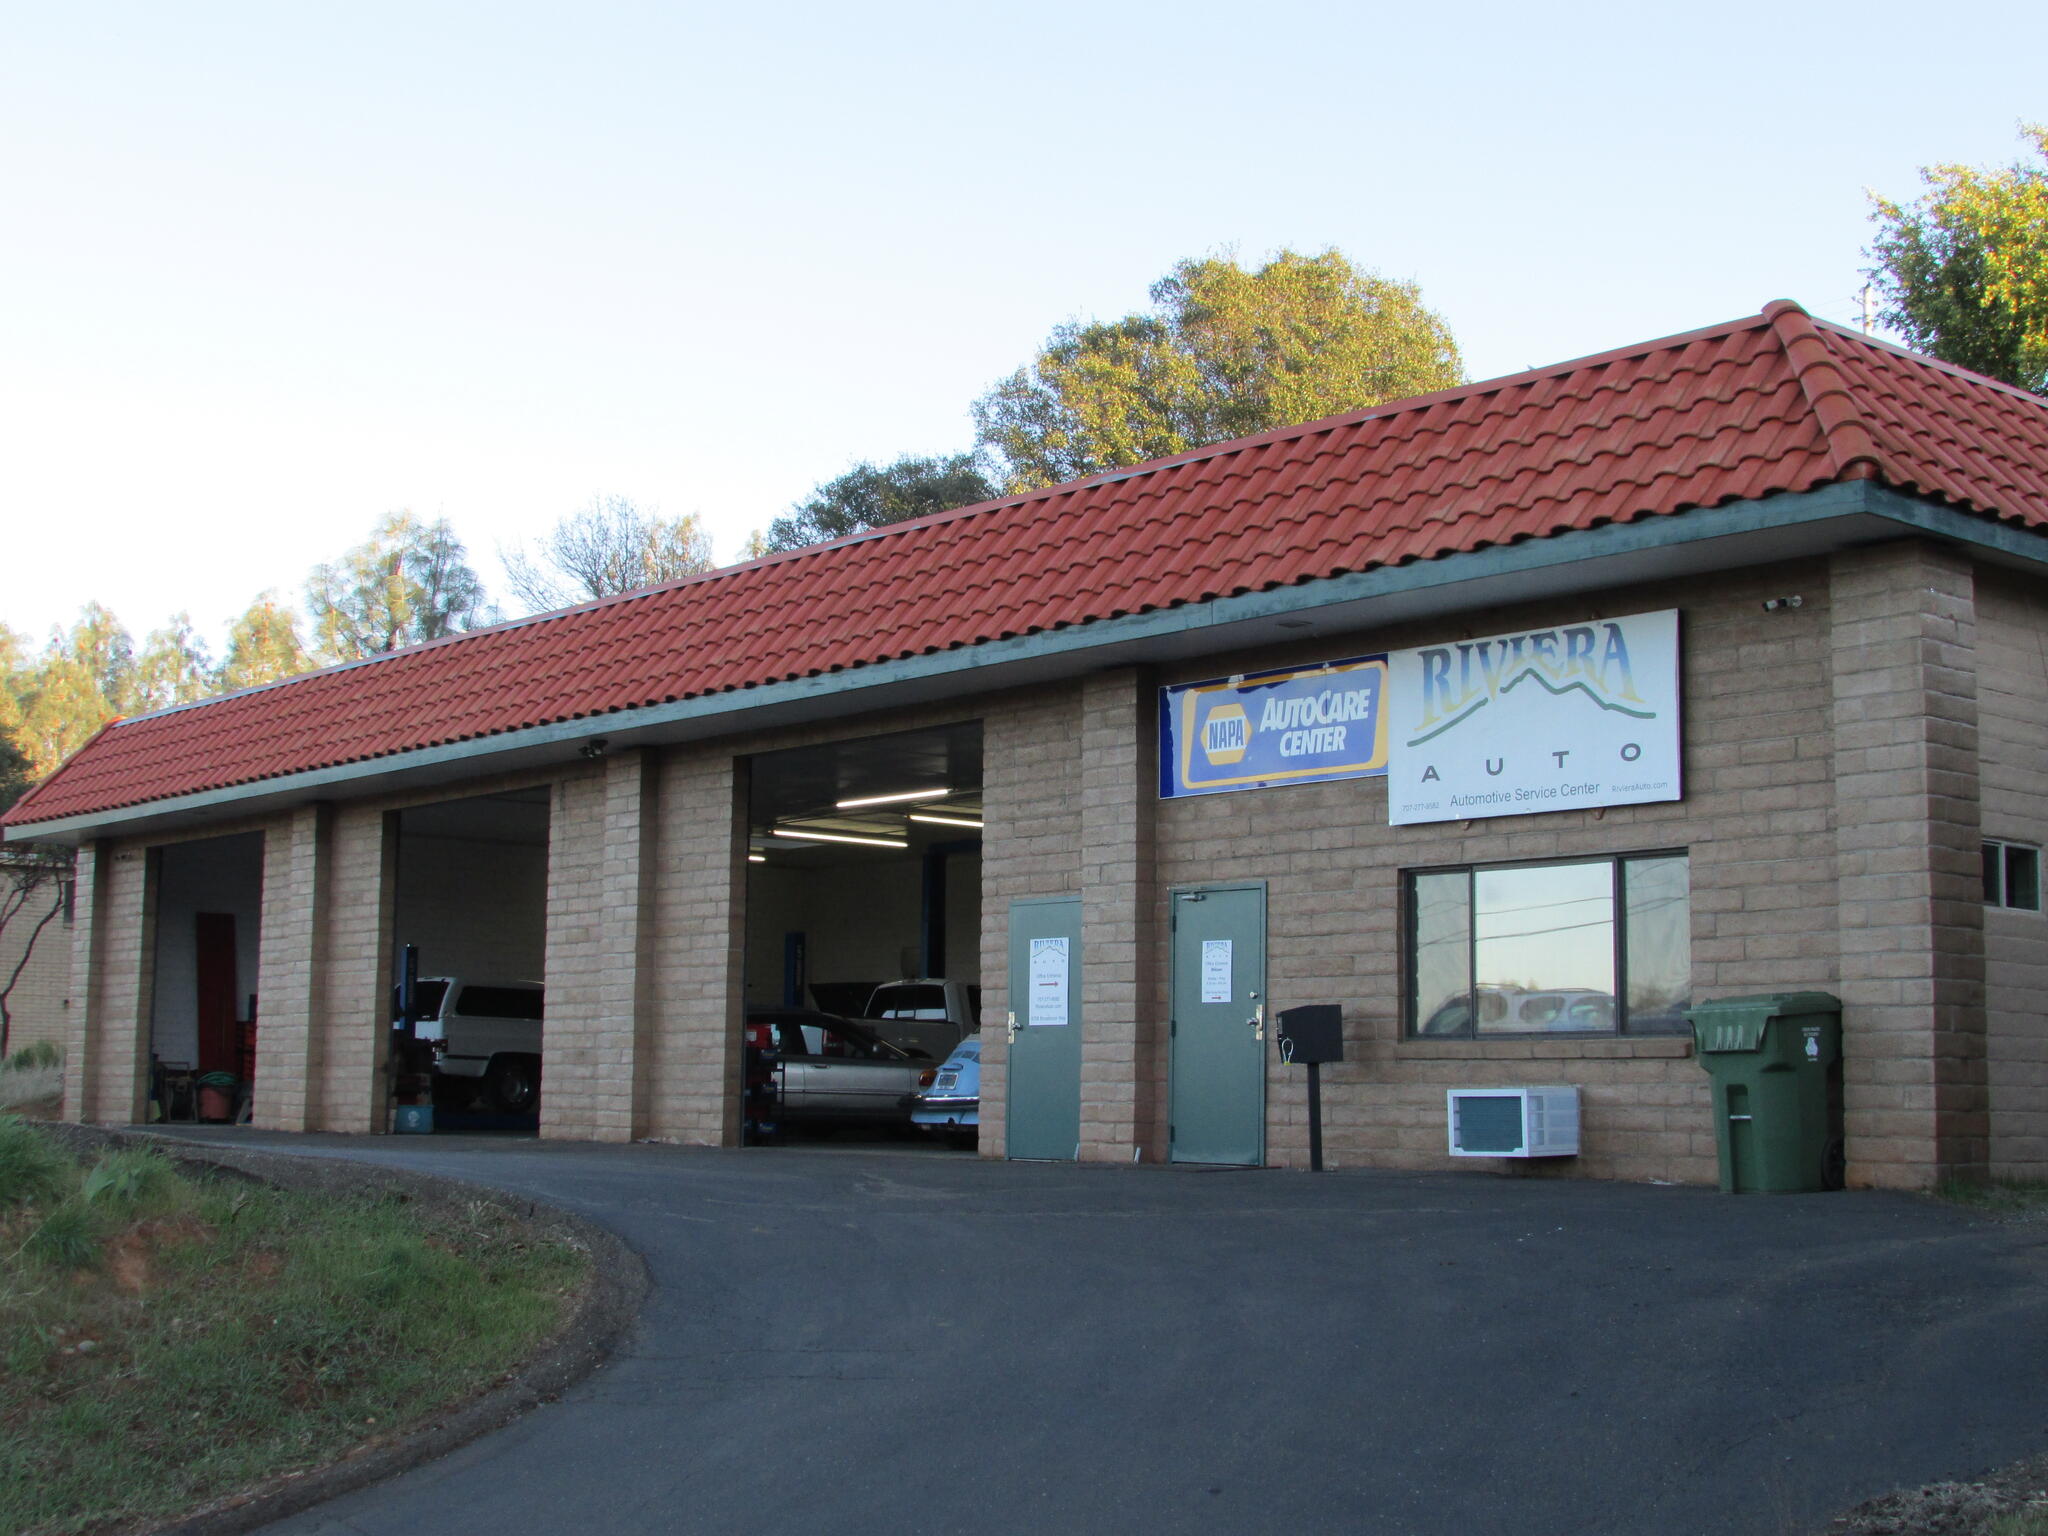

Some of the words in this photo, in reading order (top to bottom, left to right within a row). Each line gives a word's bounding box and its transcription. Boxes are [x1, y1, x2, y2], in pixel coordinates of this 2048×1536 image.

[1413, 622, 1646, 732] RIVIERA
[1208, 717, 1245, 750] NAPA
[1280, 726, 1347, 757] CENTER
[1450, 791, 1512, 808] Automotive
[1514, 787, 1557, 801] Service
[1560, 783, 1600, 798] Center
